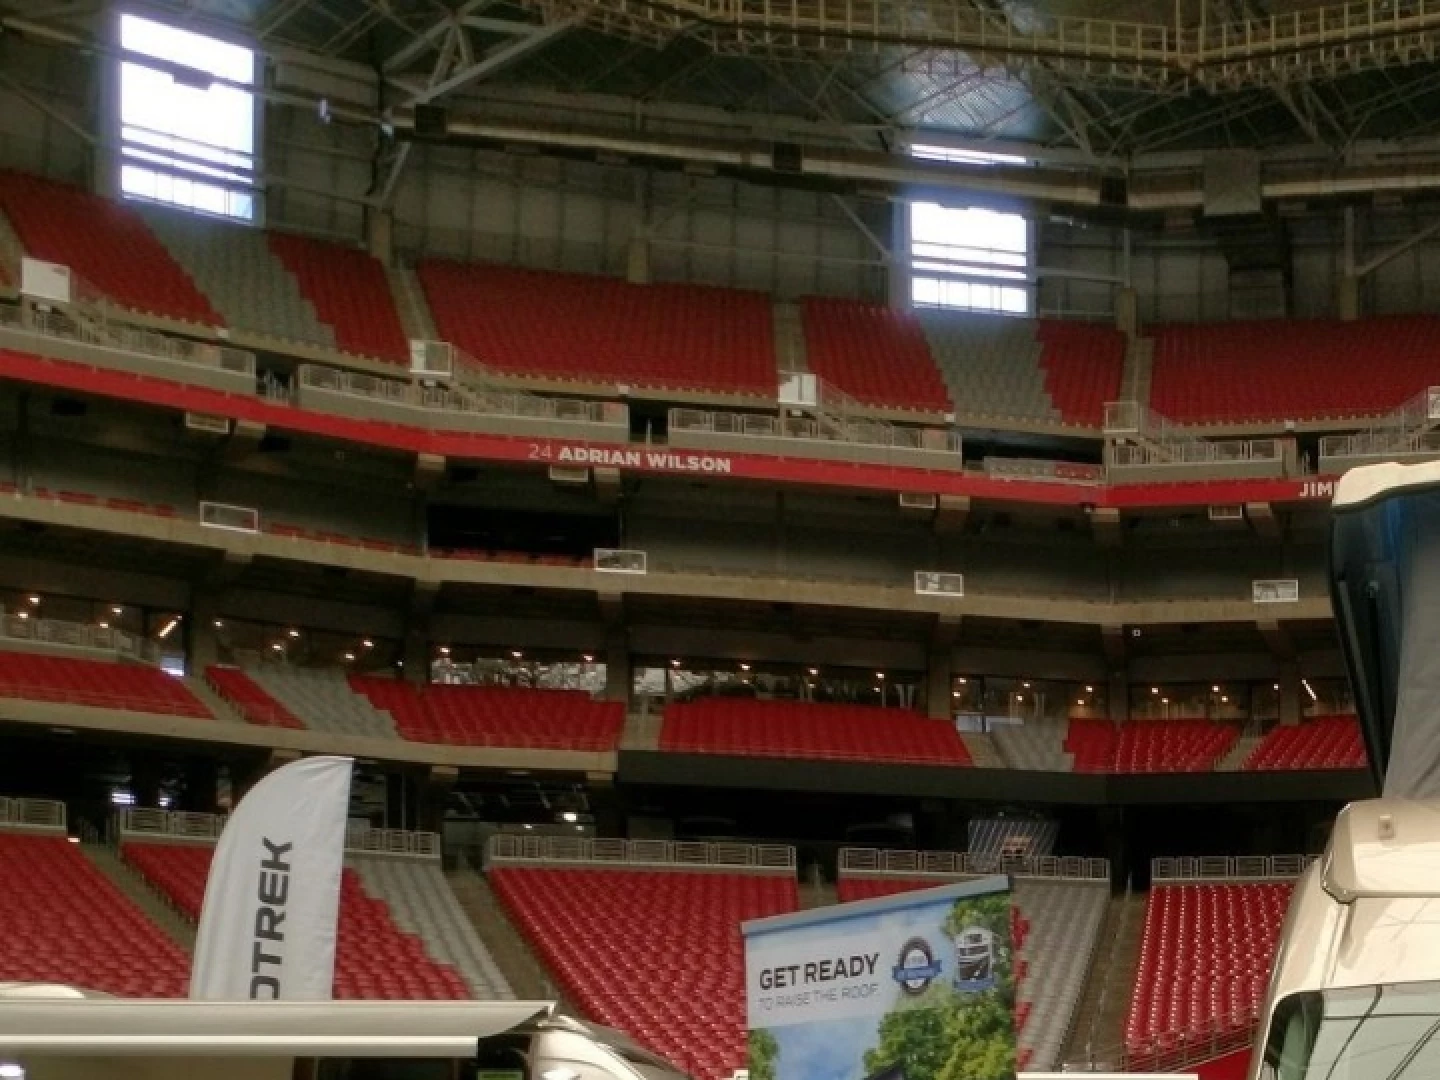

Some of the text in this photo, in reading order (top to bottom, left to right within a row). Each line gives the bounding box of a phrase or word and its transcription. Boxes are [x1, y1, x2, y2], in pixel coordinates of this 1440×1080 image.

[528, 443, 731, 473] 24 ADRIAN WILSON
[1298, 481, 1341, 498] JIM
[759, 964, 801, 991] GET
[803, 952, 881, 984] READY
[812, 986, 838, 1003] THE
[841, 982, 880, 1000] ROOF
